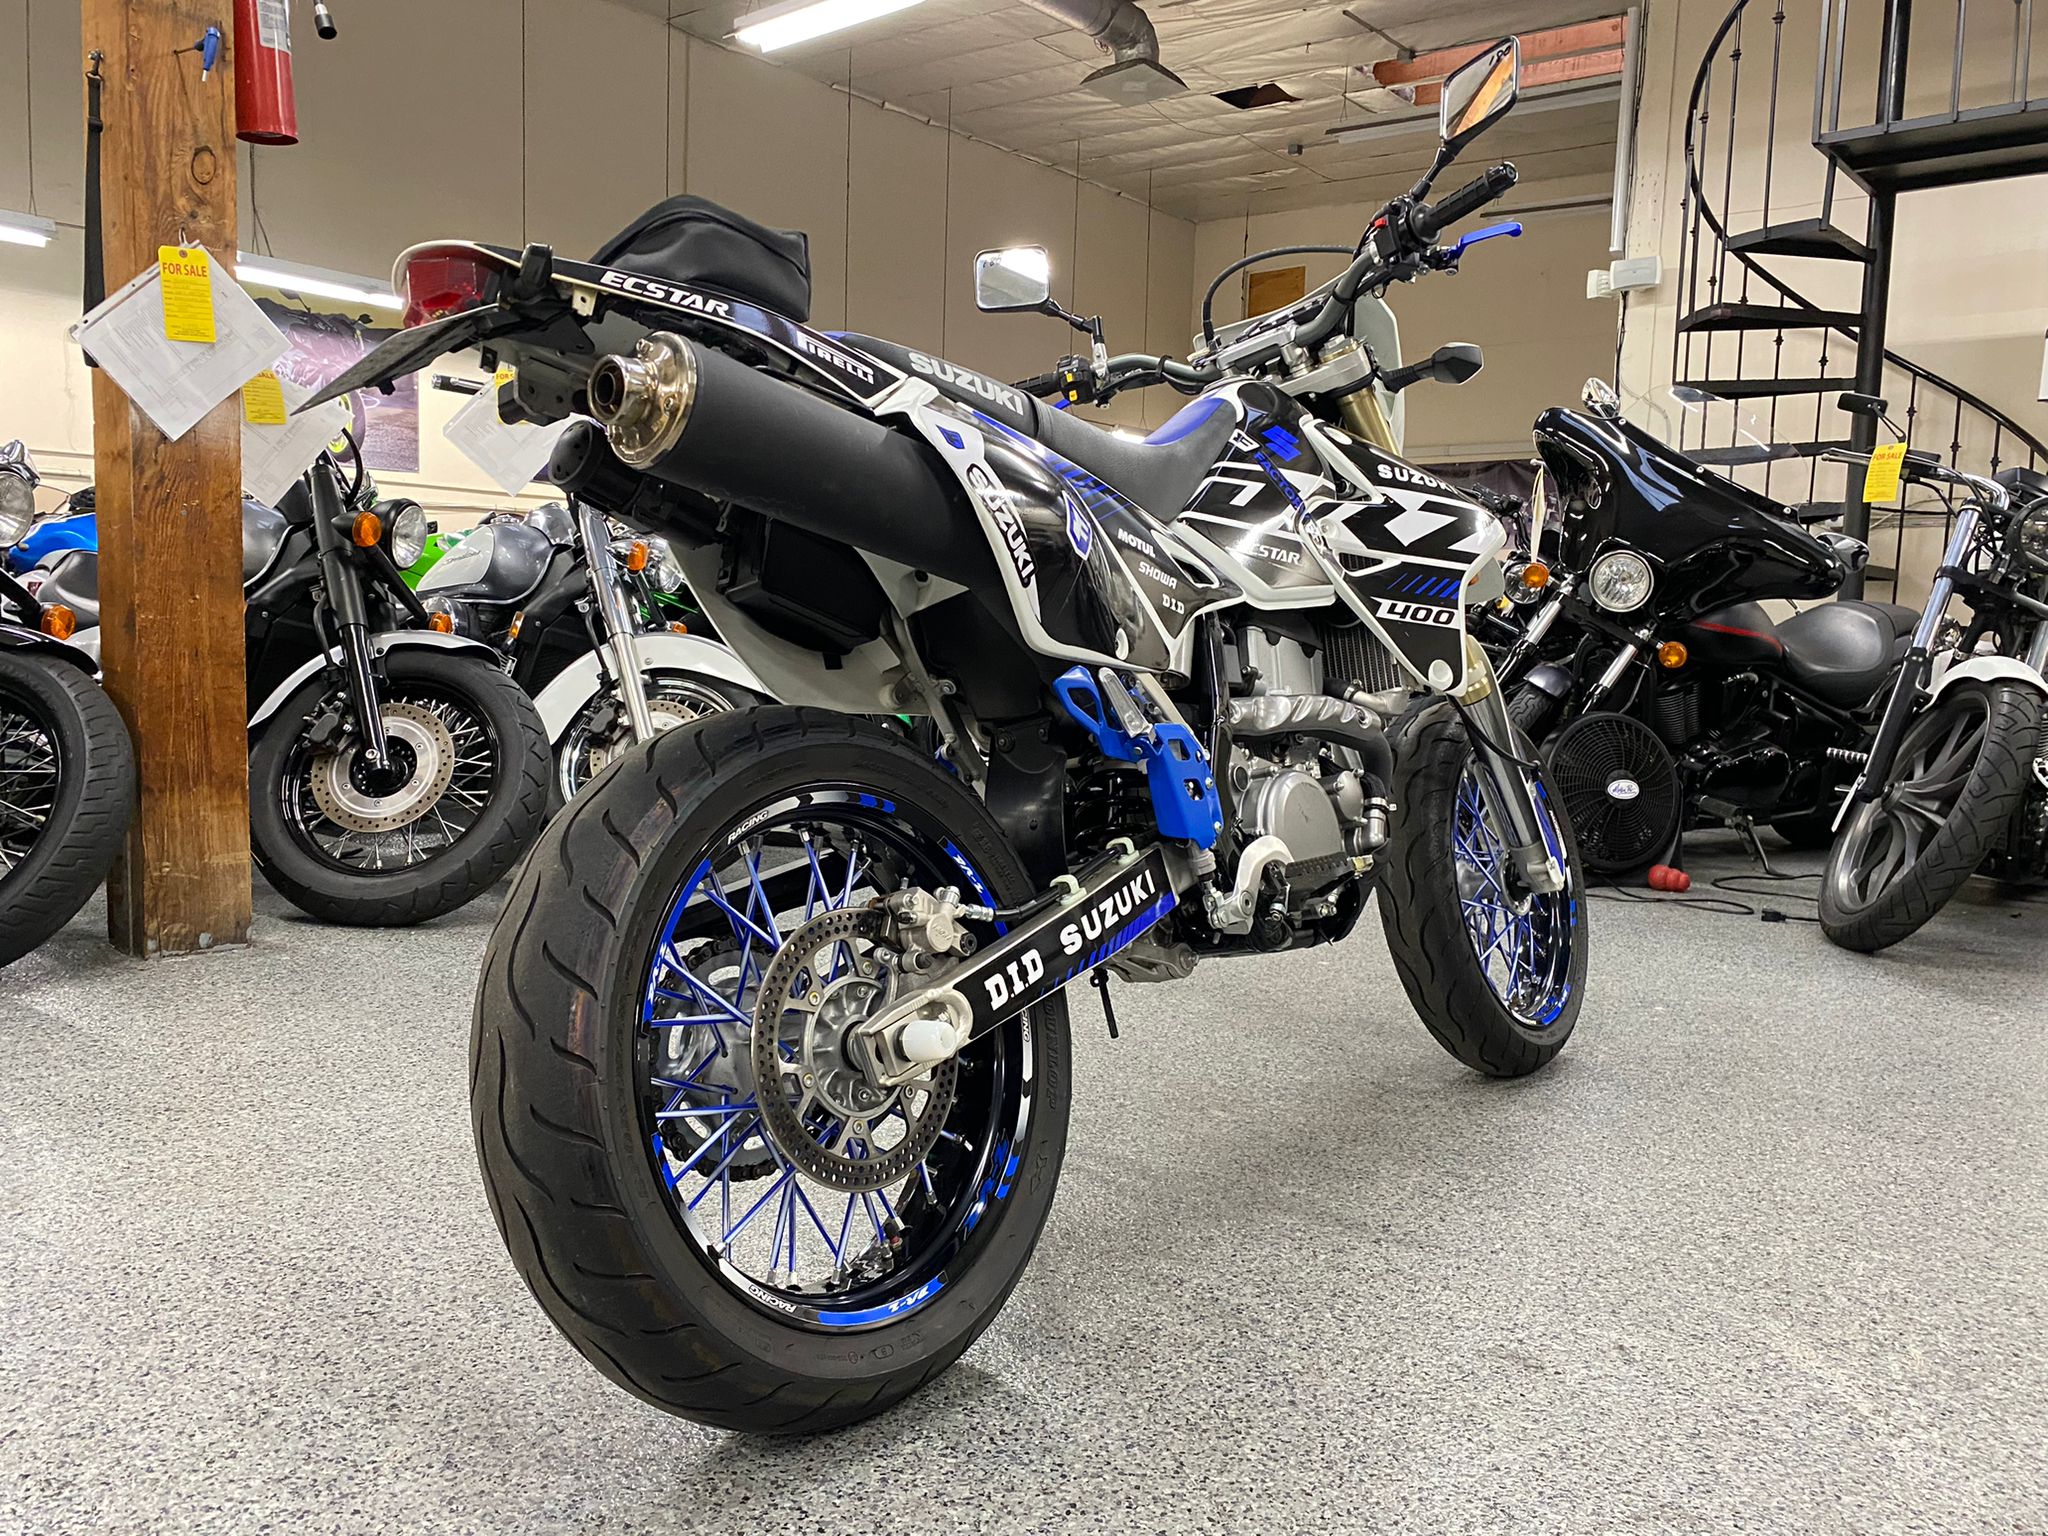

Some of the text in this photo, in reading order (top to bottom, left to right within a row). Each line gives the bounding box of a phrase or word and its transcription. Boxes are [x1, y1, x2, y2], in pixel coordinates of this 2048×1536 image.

[163, 263, 207, 278] FOR SALE
[600, 270, 735, 320] ECSTAR
[796, 330, 874, 385] PIRELLI
[908, 352, 1024, 416] SUZUKI
[1873, 451, 1903, 461] FOR SALE
[1254, 451, 1305, 513] FACTOR
[1117, 528, 1156, 559] MOTUL
[1138, 561, 1178, 590] SHOWA
[1387, 603, 1456, 625] 400
[727, 809, 769, 845] RACING
[1059, 869, 1156, 956] SUZUKI
[749, 1285, 798, 1314] RACING
